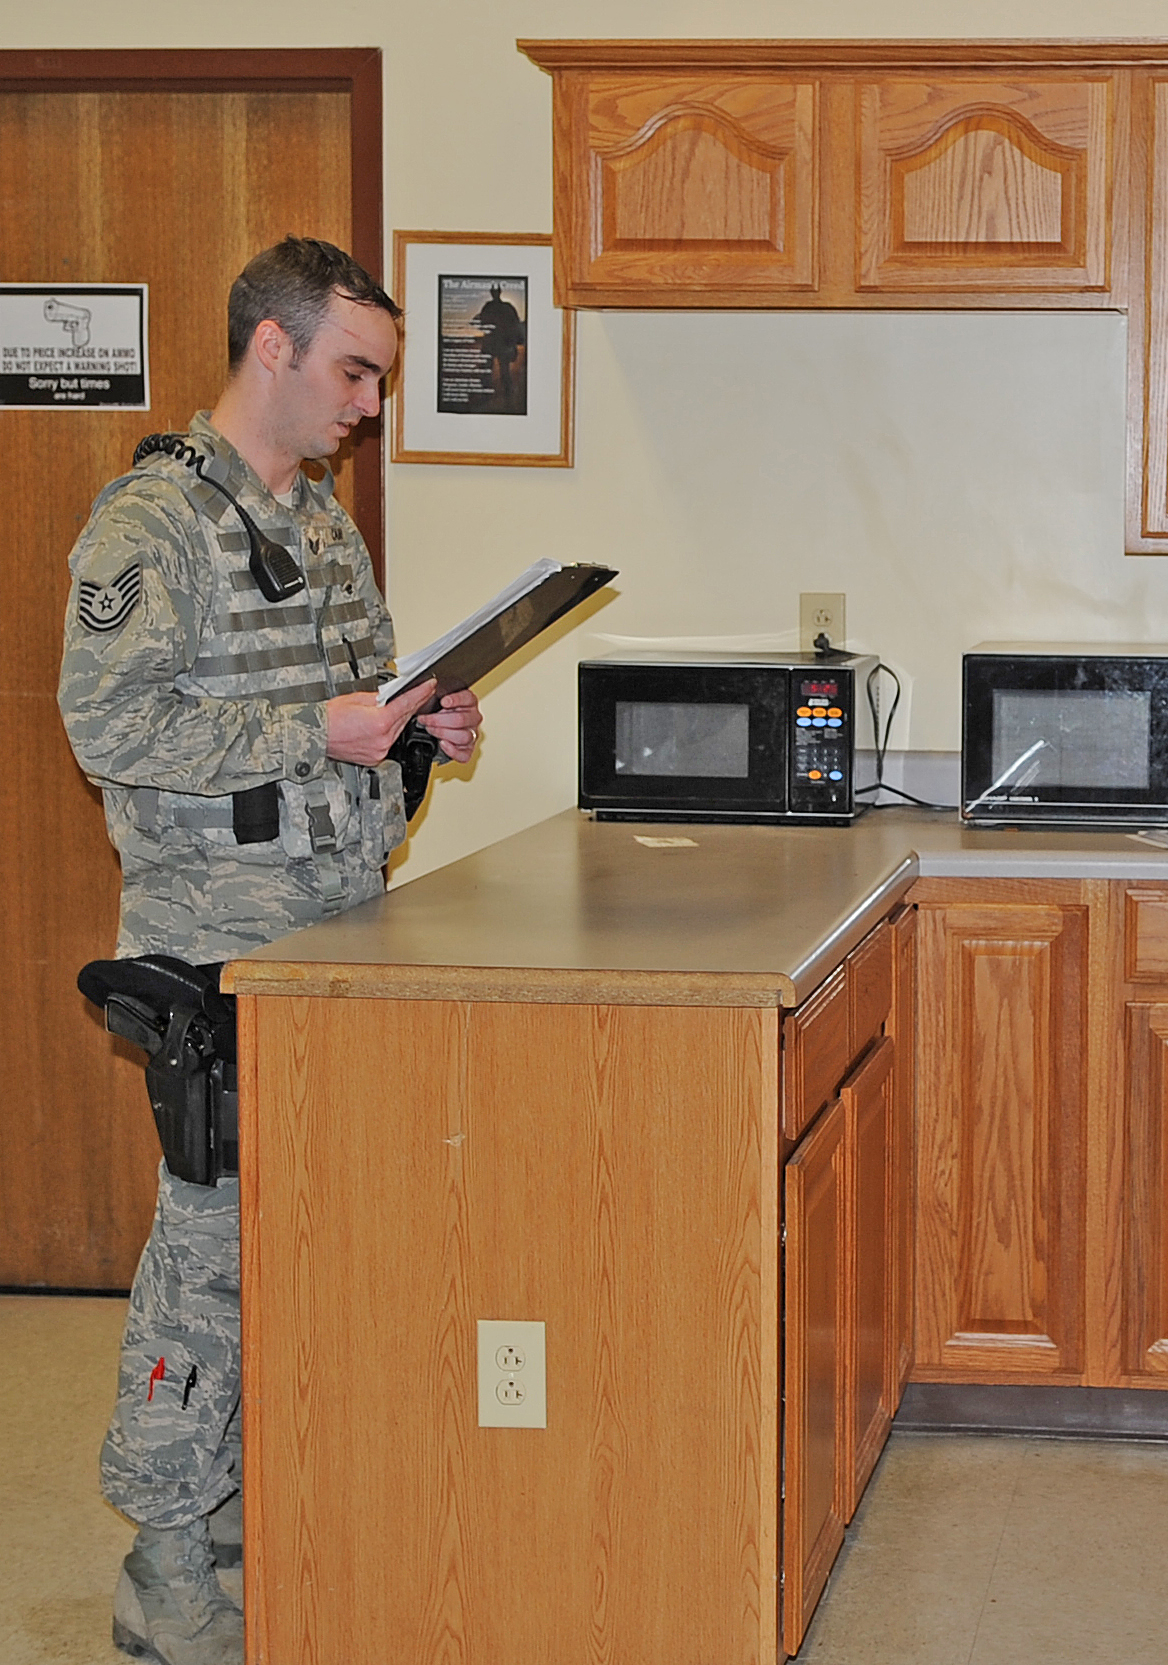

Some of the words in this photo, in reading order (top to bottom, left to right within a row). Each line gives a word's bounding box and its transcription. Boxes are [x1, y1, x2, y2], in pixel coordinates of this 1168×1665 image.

[443, 279, 460, 289] The
[2, 347, 18, 358] DUE
[21, 347, 31, 358] TO
[33, 347, 55, 358] PRICE
[58, 347, 96, 358] INCREASE
[98, 348, 109, 358] ON
[112, 348, 136, 358] AMMO
[2, 361, 12, 371] DO
[15, 361, 31, 371] NOT
[34, 361, 63, 371] EXPECT
[66, 361, 71, 371] A
[74, 361, 111, 372] WARNING
[28, 376, 58, 392] Sorry
[60, 377, 79, 389] but
[80, 377, 111, 390] times
[68, 392, 86, 400] hard
